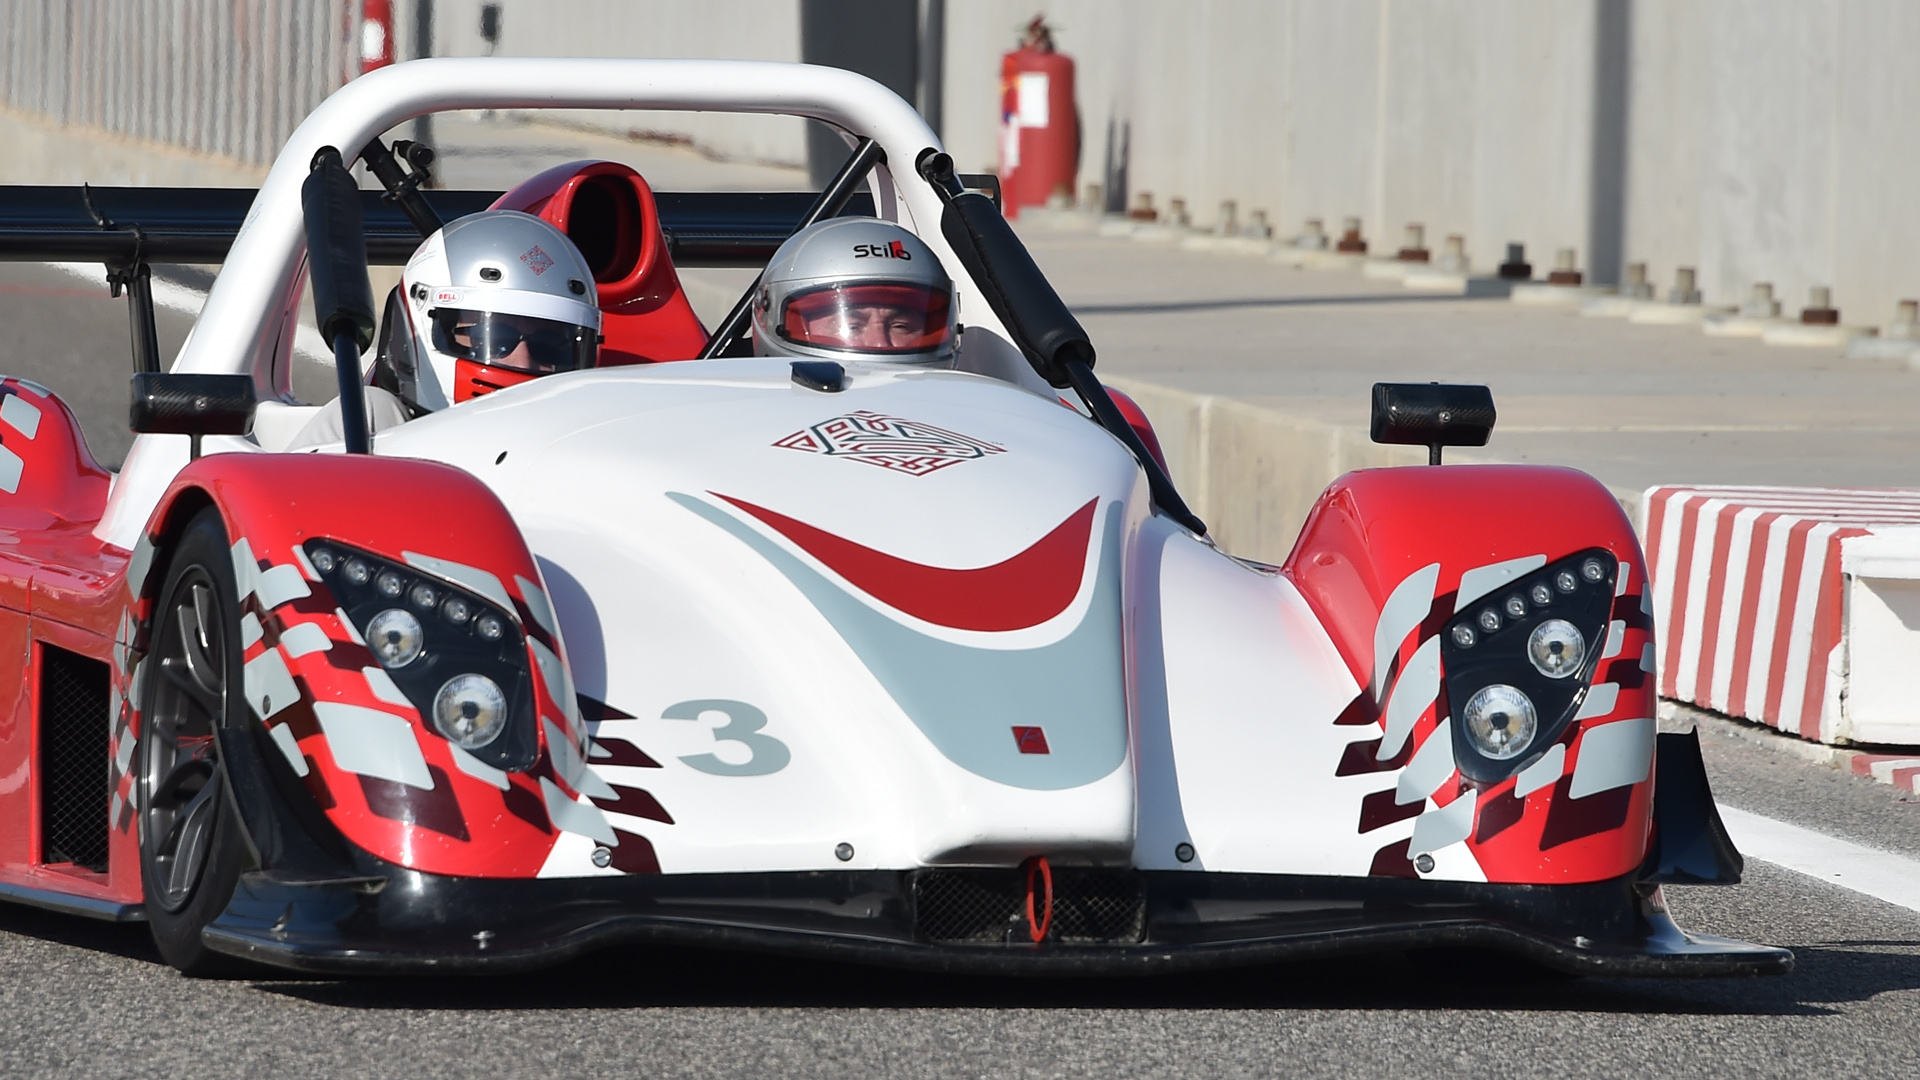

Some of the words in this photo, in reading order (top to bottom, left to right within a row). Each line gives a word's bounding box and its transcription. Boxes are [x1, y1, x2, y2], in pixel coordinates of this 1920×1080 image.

[853, 241, 912, 261] Stilo
[438, 293, 457, 301] BELL
[660, 699, 792, 777] 3
